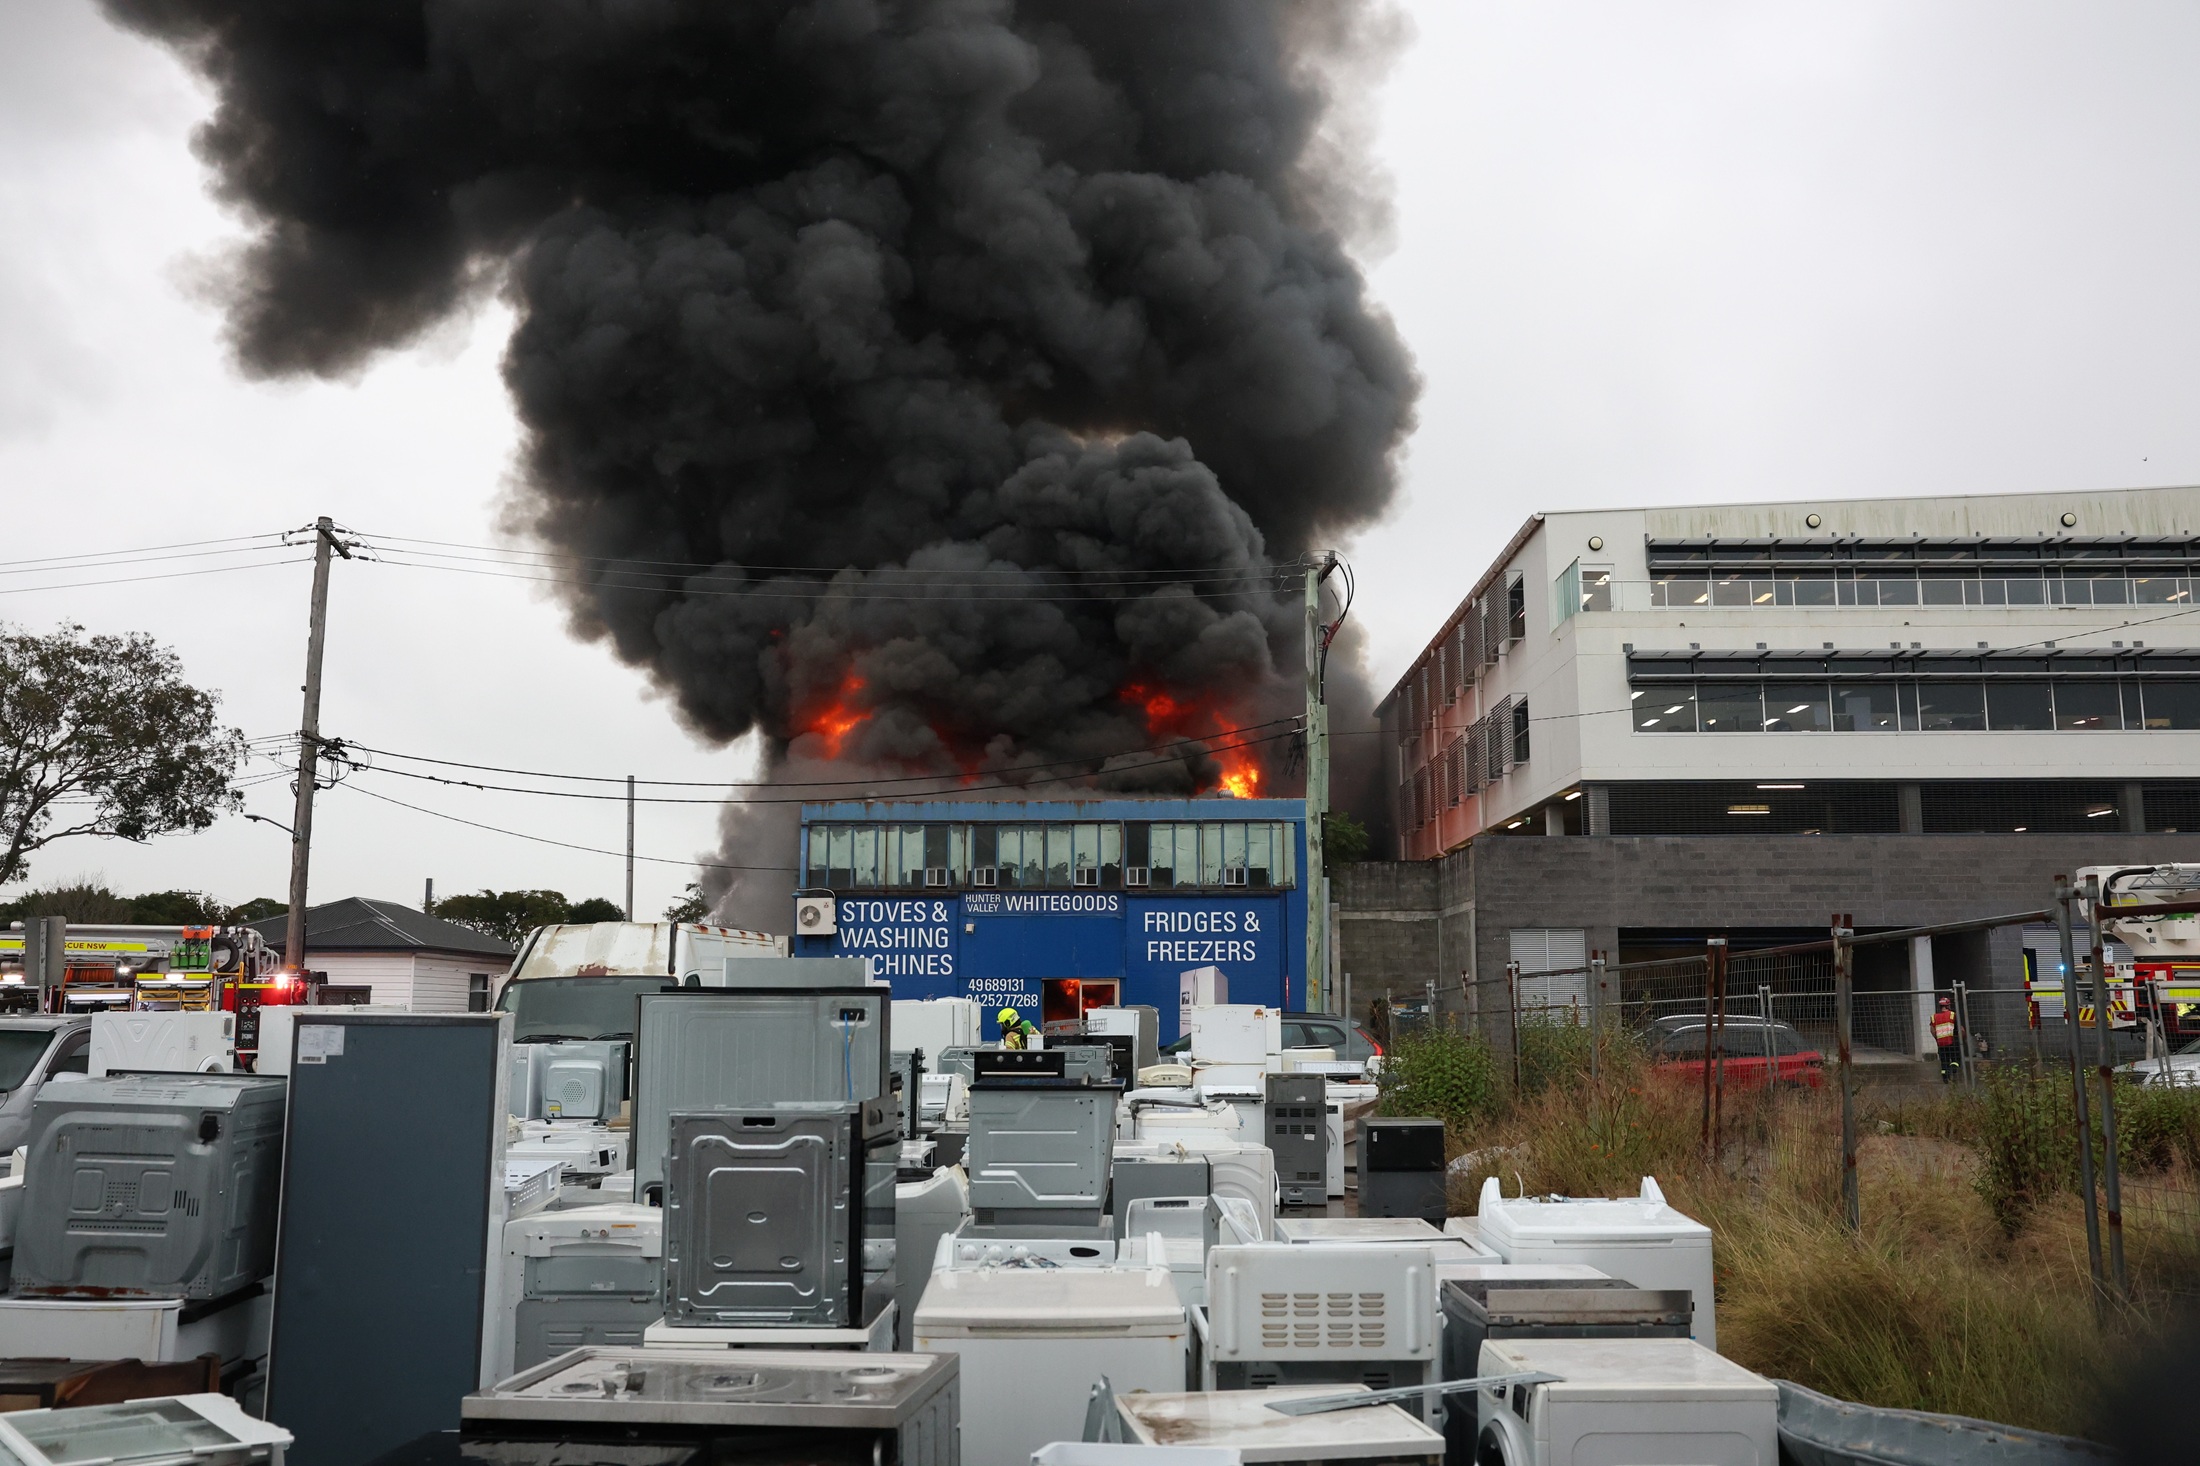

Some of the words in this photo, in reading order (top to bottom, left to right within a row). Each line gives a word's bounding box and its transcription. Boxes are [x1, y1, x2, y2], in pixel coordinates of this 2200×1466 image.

[965, 894, 1001, 903] HUNTER
[966, 903, 999, 913] VALLEY
[1005, 895, 1118, 912] WHITEGOODS
[842, 901, 927, 923] STOVES
[931, 901, 949, 923] &
[1144, 911, 1237, 933] FRIDGES
[1243, 911, 1261, 933] &
[840, 927, 949, 949] WASHING
[1147, 940, 1256, 962] FREEZERS
[834, 954, 953, 975] CHINES
[968, 978, 1025, 992] 49689131
